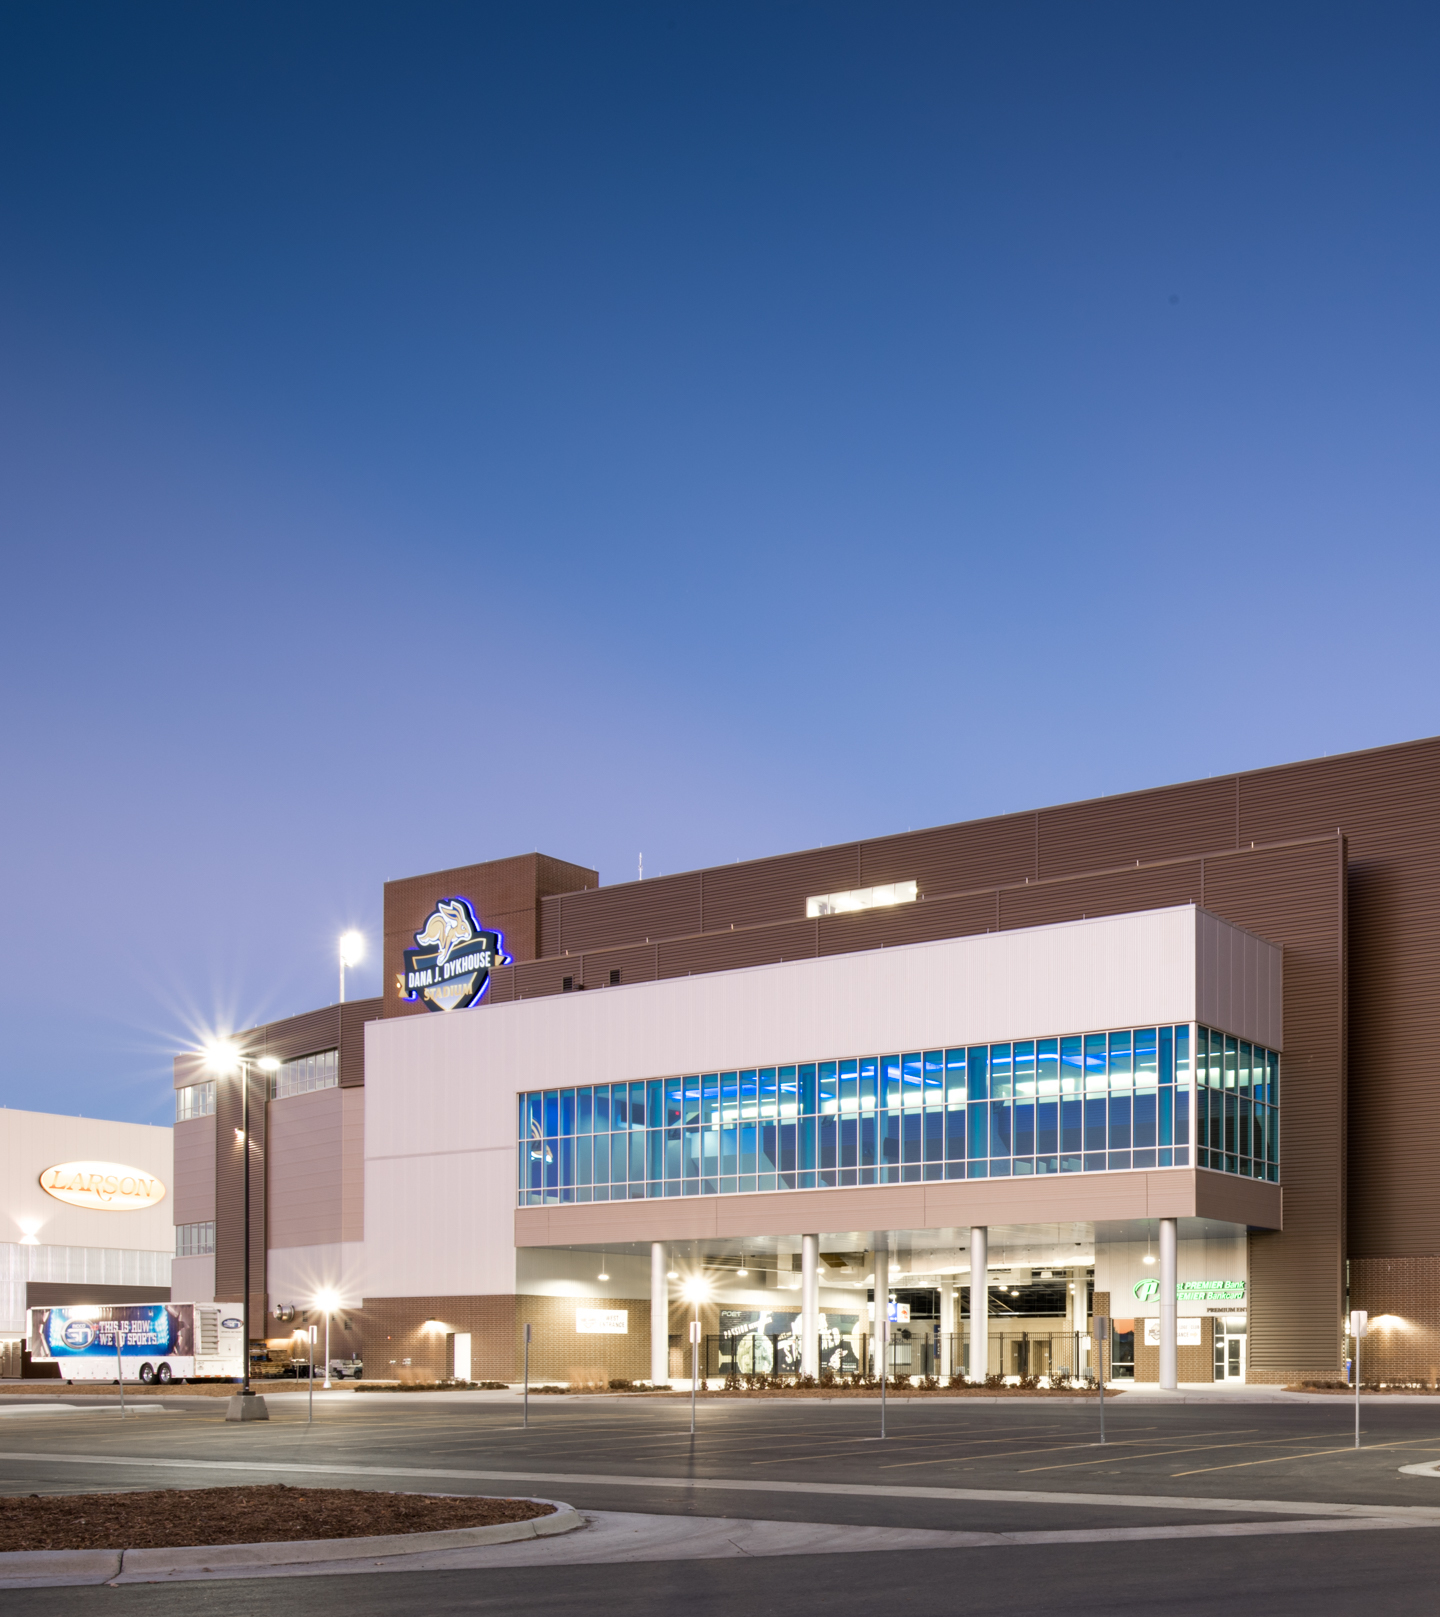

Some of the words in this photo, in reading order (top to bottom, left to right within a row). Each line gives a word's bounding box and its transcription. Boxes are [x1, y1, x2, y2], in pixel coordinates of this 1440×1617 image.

[408, 969, 432, 988] DANA
[433, 966, 442, 983] J.
[443, 951, 491, 979] DYKHOUSE
[424, 983, 473, 1001] STADIUM
[48, 1170, 155, 1202] LARSON
[1185, 1281, 1224, 1289] PREMIER
[1224, 1280, 1246, 1289] Bank
[1176, 1292, 1207, 1301] EMIER
[1207, 1291, 1245, 1300] Bankcard
[99, 1321, 118, 1333] THIS
[120, 1321, 129, 1332] IS
[131, 1320, 151, 1332] HOW
[99, 1333, 113, 1345] WE
